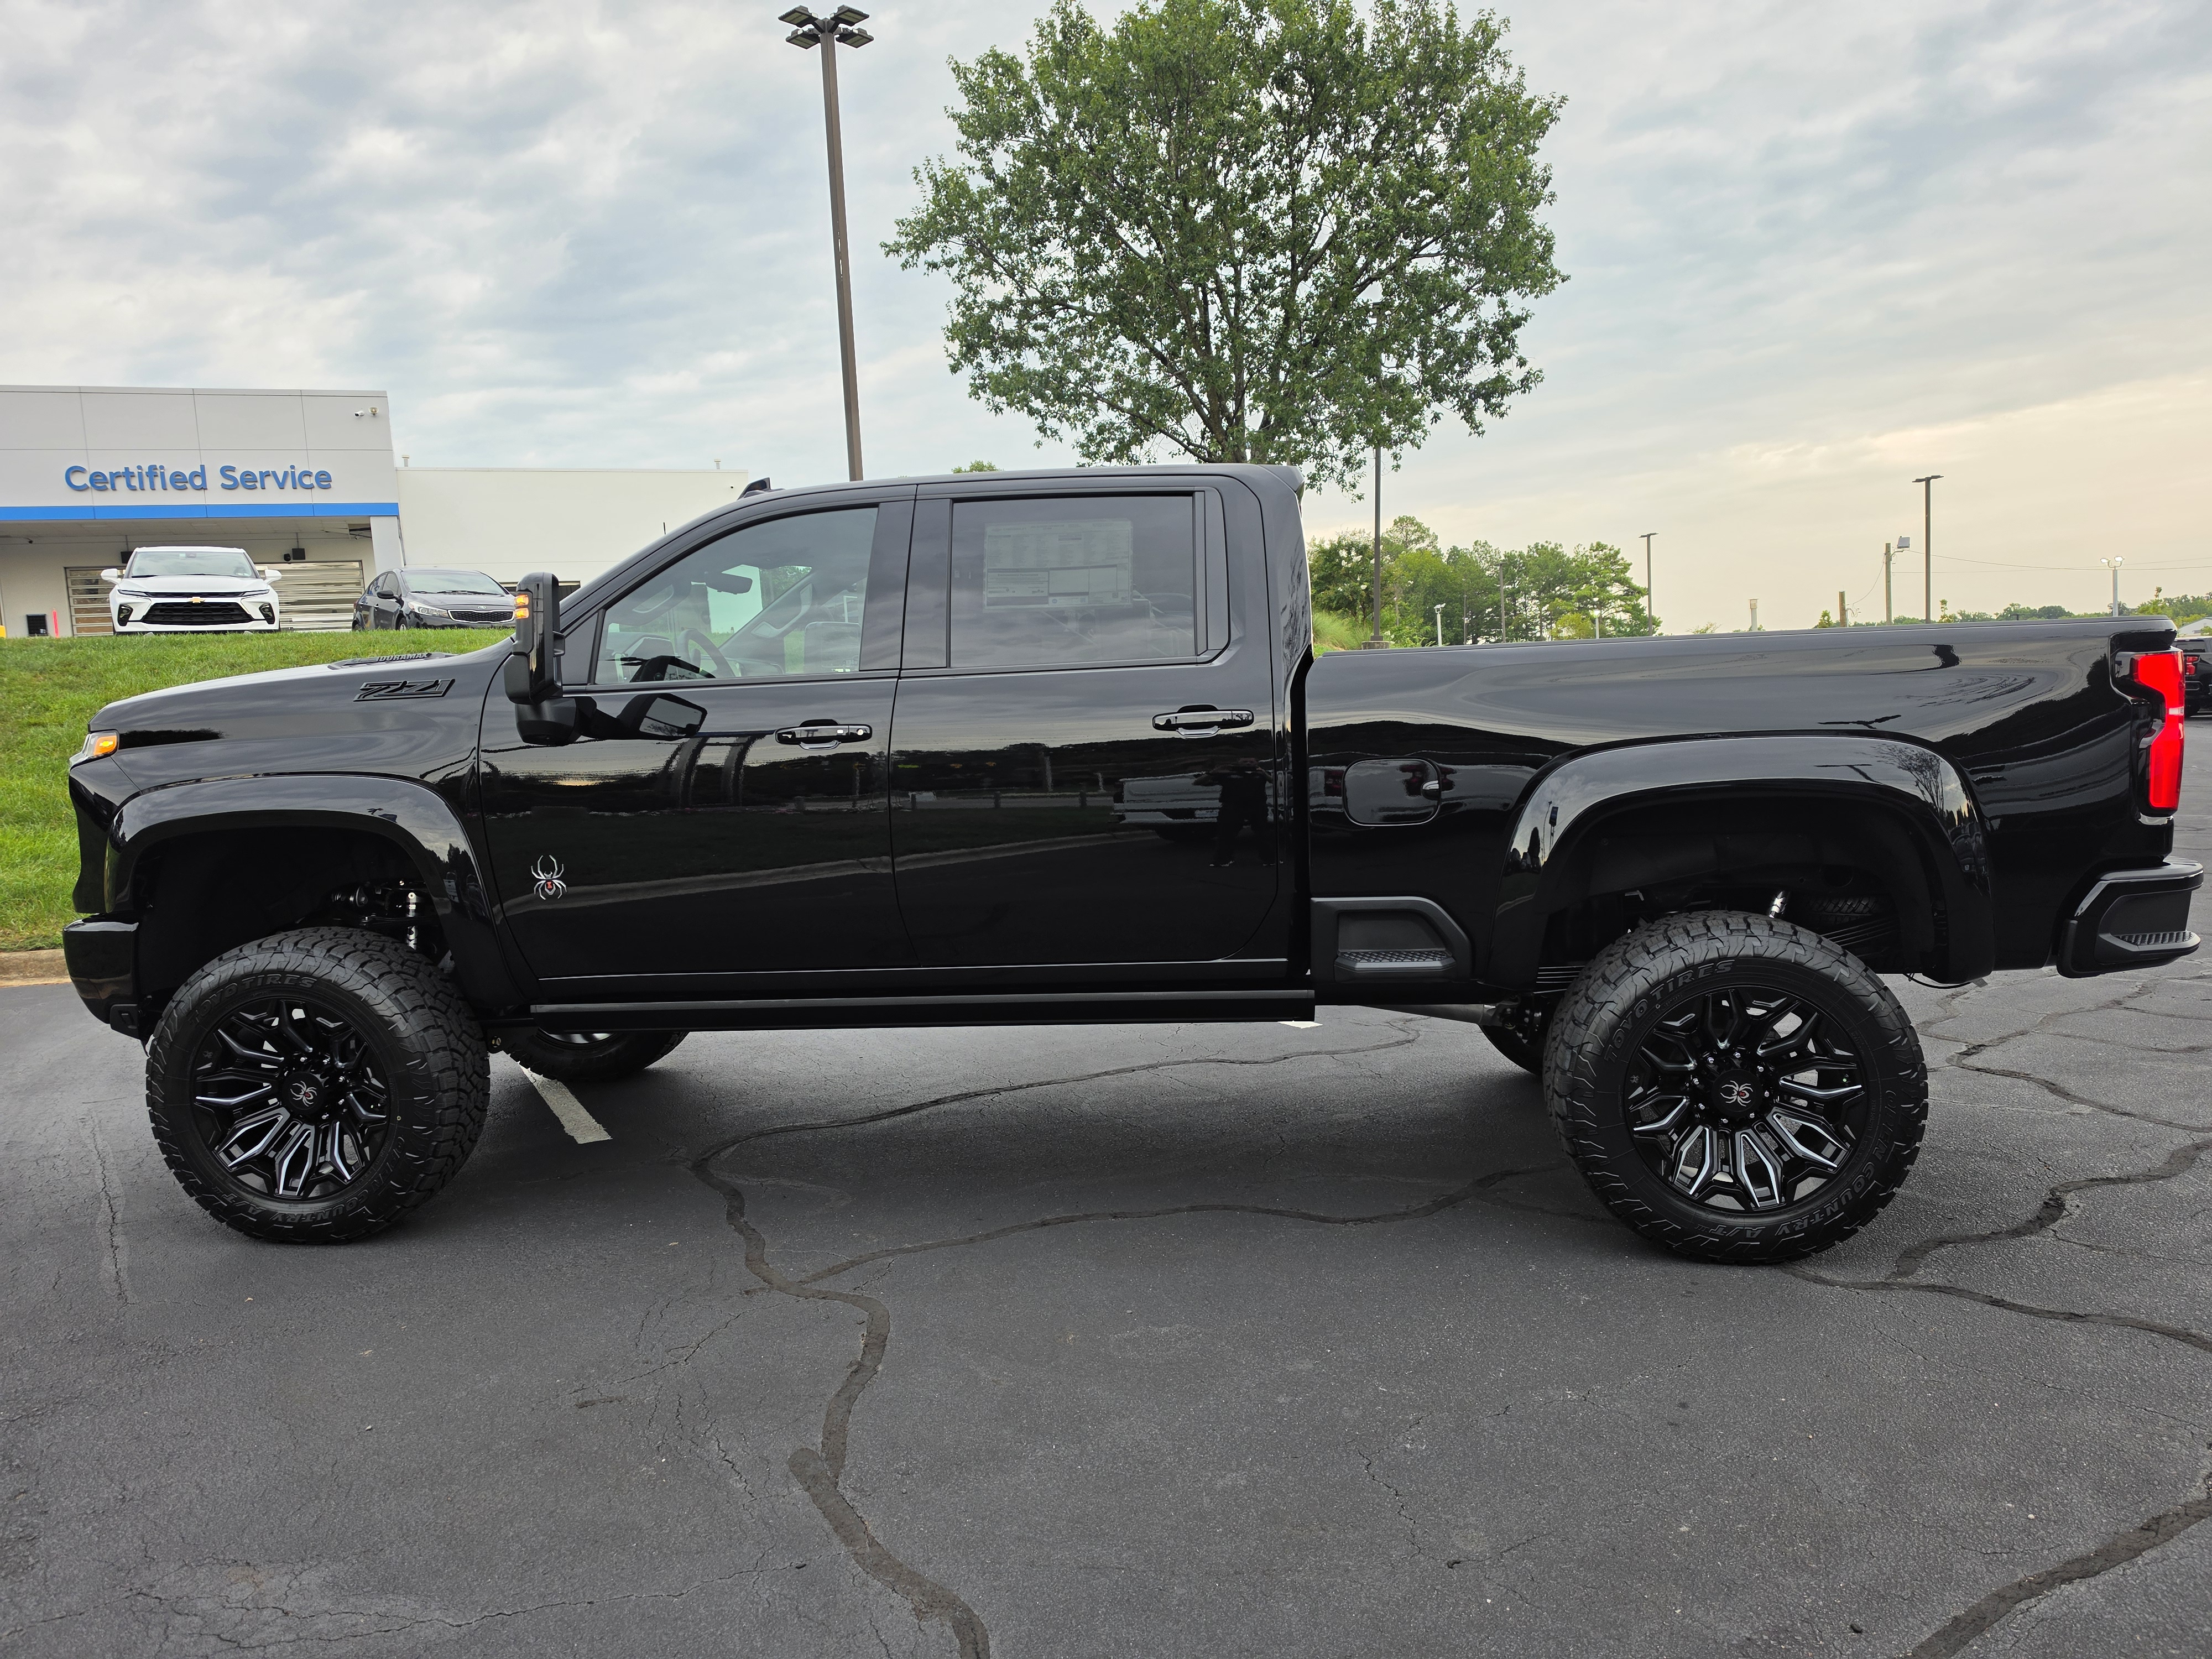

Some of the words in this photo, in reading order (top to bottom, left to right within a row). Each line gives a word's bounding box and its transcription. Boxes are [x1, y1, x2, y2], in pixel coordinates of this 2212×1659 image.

[65, 463, 207, 491] Certified
[220, 464, 332, 491] Service
[377, 653, 430, 662] DURAMAX
[352, 679, 455, 702] Z71
[187, 983, 238, 1026] TOYO
[241, 973, 317, 989] TIRES
[1604, 999, 1648, 1063] TOYO
[1650, 959, 1735, 1000] TIRES
[269, 1189, 369, 1223] COUNTRY
[1774, 1161, 1876, 1237] COUNTRY
